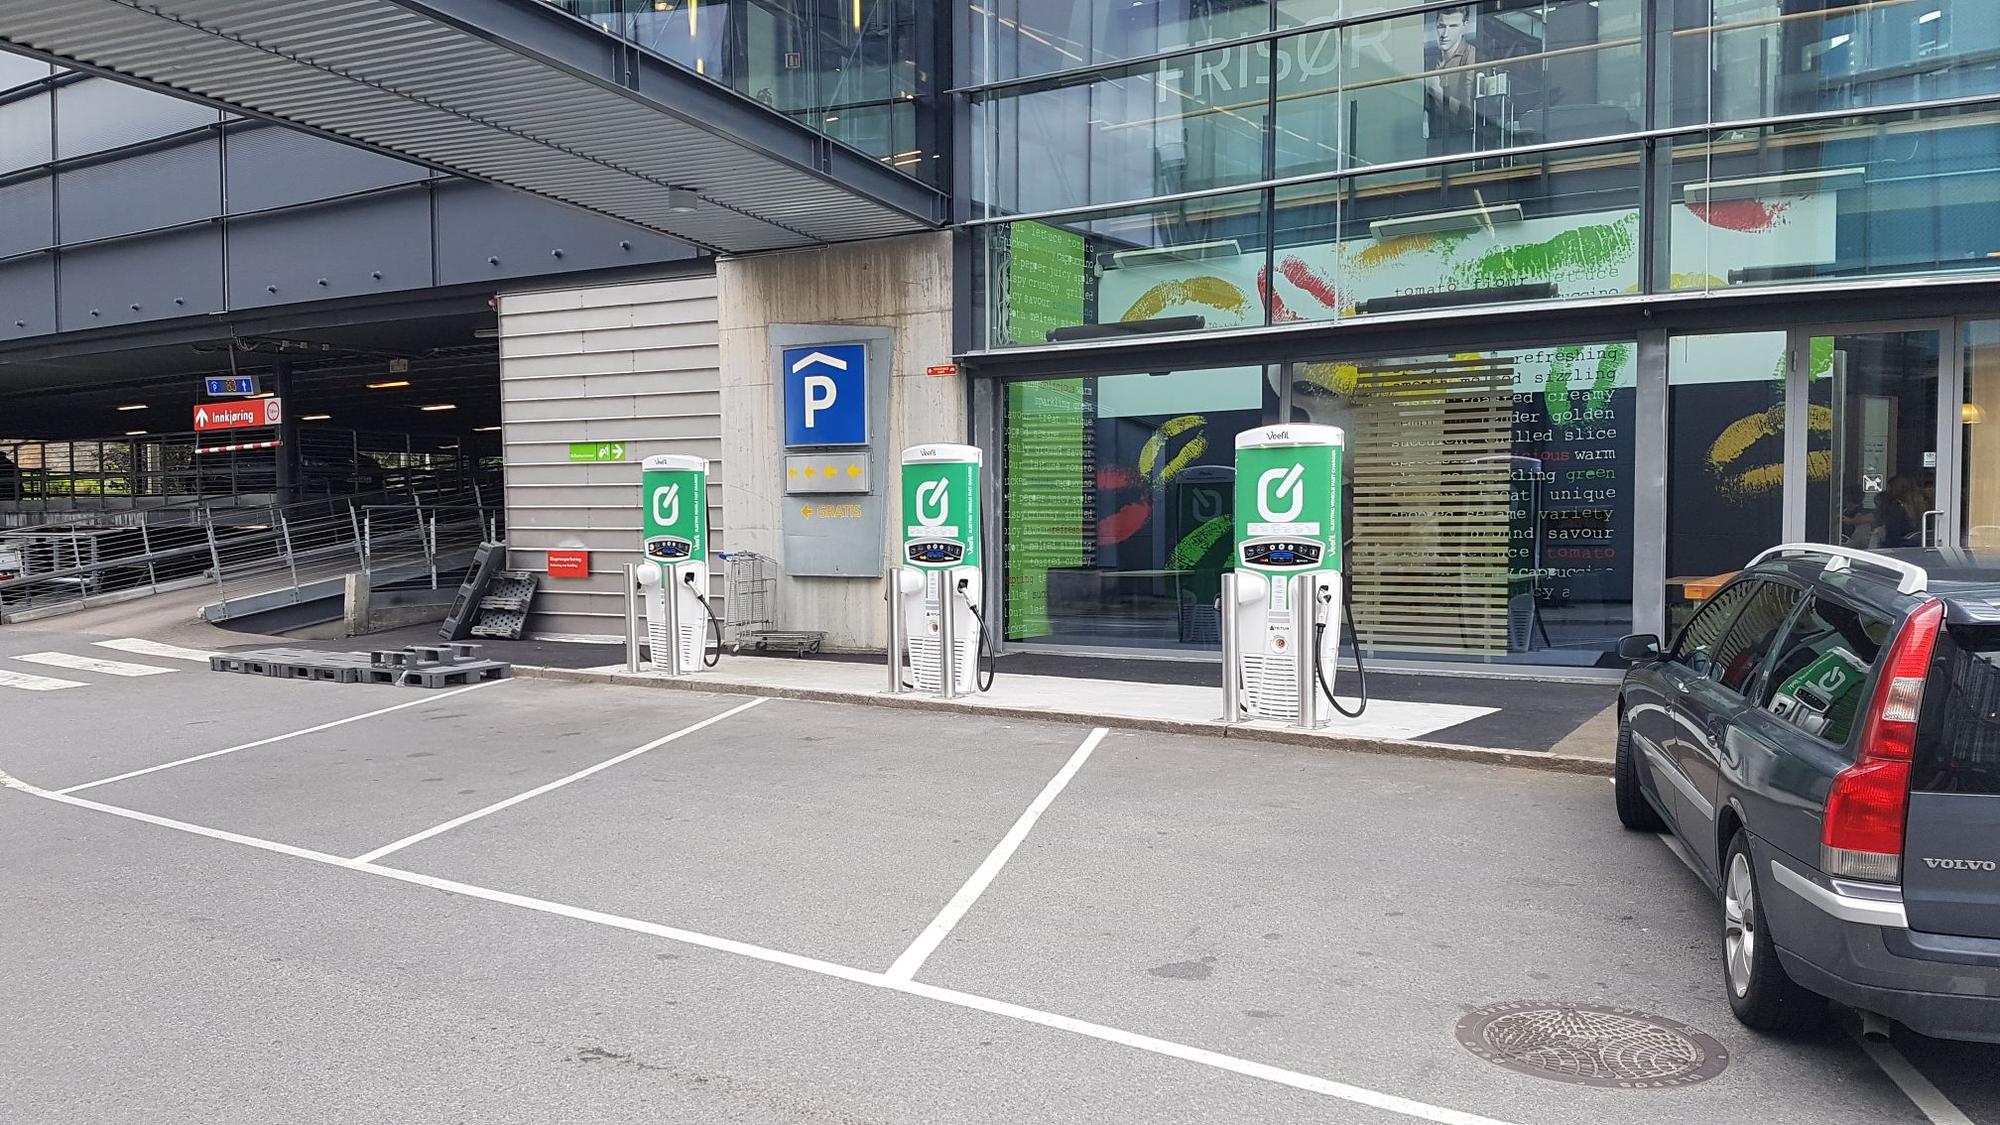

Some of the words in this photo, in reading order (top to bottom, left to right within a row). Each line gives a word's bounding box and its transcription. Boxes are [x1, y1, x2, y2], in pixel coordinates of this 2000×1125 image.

[1158, 8, 1393, 103] FRISØR
[1514, 348, 1618, 365] refreshing
[1535, 368, 1616, 384] sizzling
[804, 376, 837, 428] P
[1547, 388, 1616, 403] creamy
[212, 409, 254, 425] Innkjøring
[1552, 407, 1616, 426] golden
[1564, 427, 1617, 441] slice
[1574, 448, 1616, 460] warm
[1566, 467, 1616, 484] green
[1549, 486, 1616, 502] unique
[817, 503, 864, 518] GRATIS
[1539, 506, 1614, 522] variety
[1548, 527, 1615, 539] savour
[1546, 547, 1616, 559] tomato
[1922, 857, 1996, 871] VOLVO
